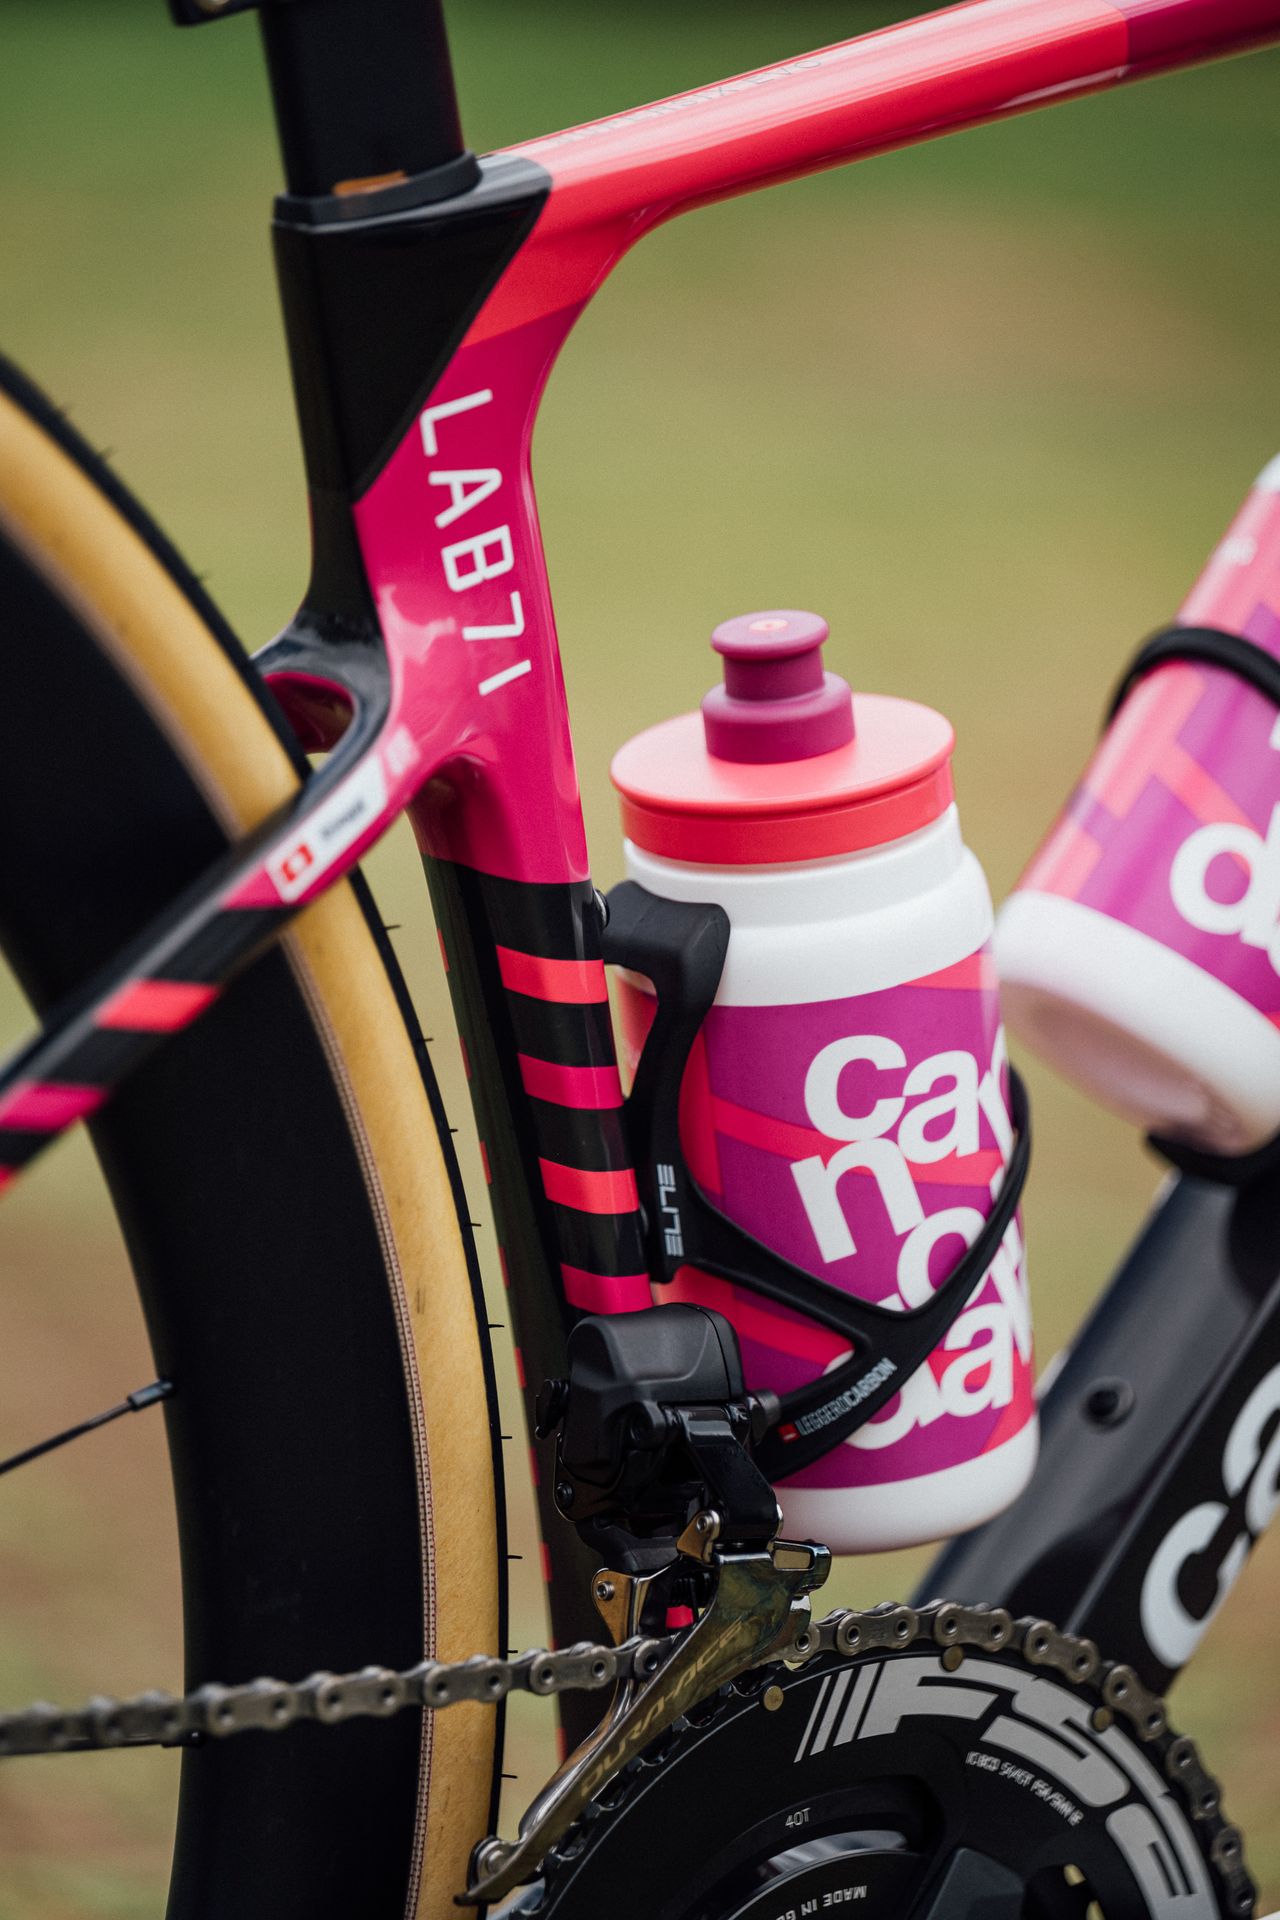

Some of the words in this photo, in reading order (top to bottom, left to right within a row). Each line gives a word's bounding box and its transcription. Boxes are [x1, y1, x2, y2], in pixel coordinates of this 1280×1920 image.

[419, 388, 532, 697] LAB71
[656, 1163, 684, 1257] ELITE
[790, 1136, 1022, 1312] no
[580, 1615, 743, 1797] DURA-ACE
[785, 1807, 811, 1829] 40T
[801, 1898, 817, 1916] IN
[823, 1885, 867, 1907] MADE
